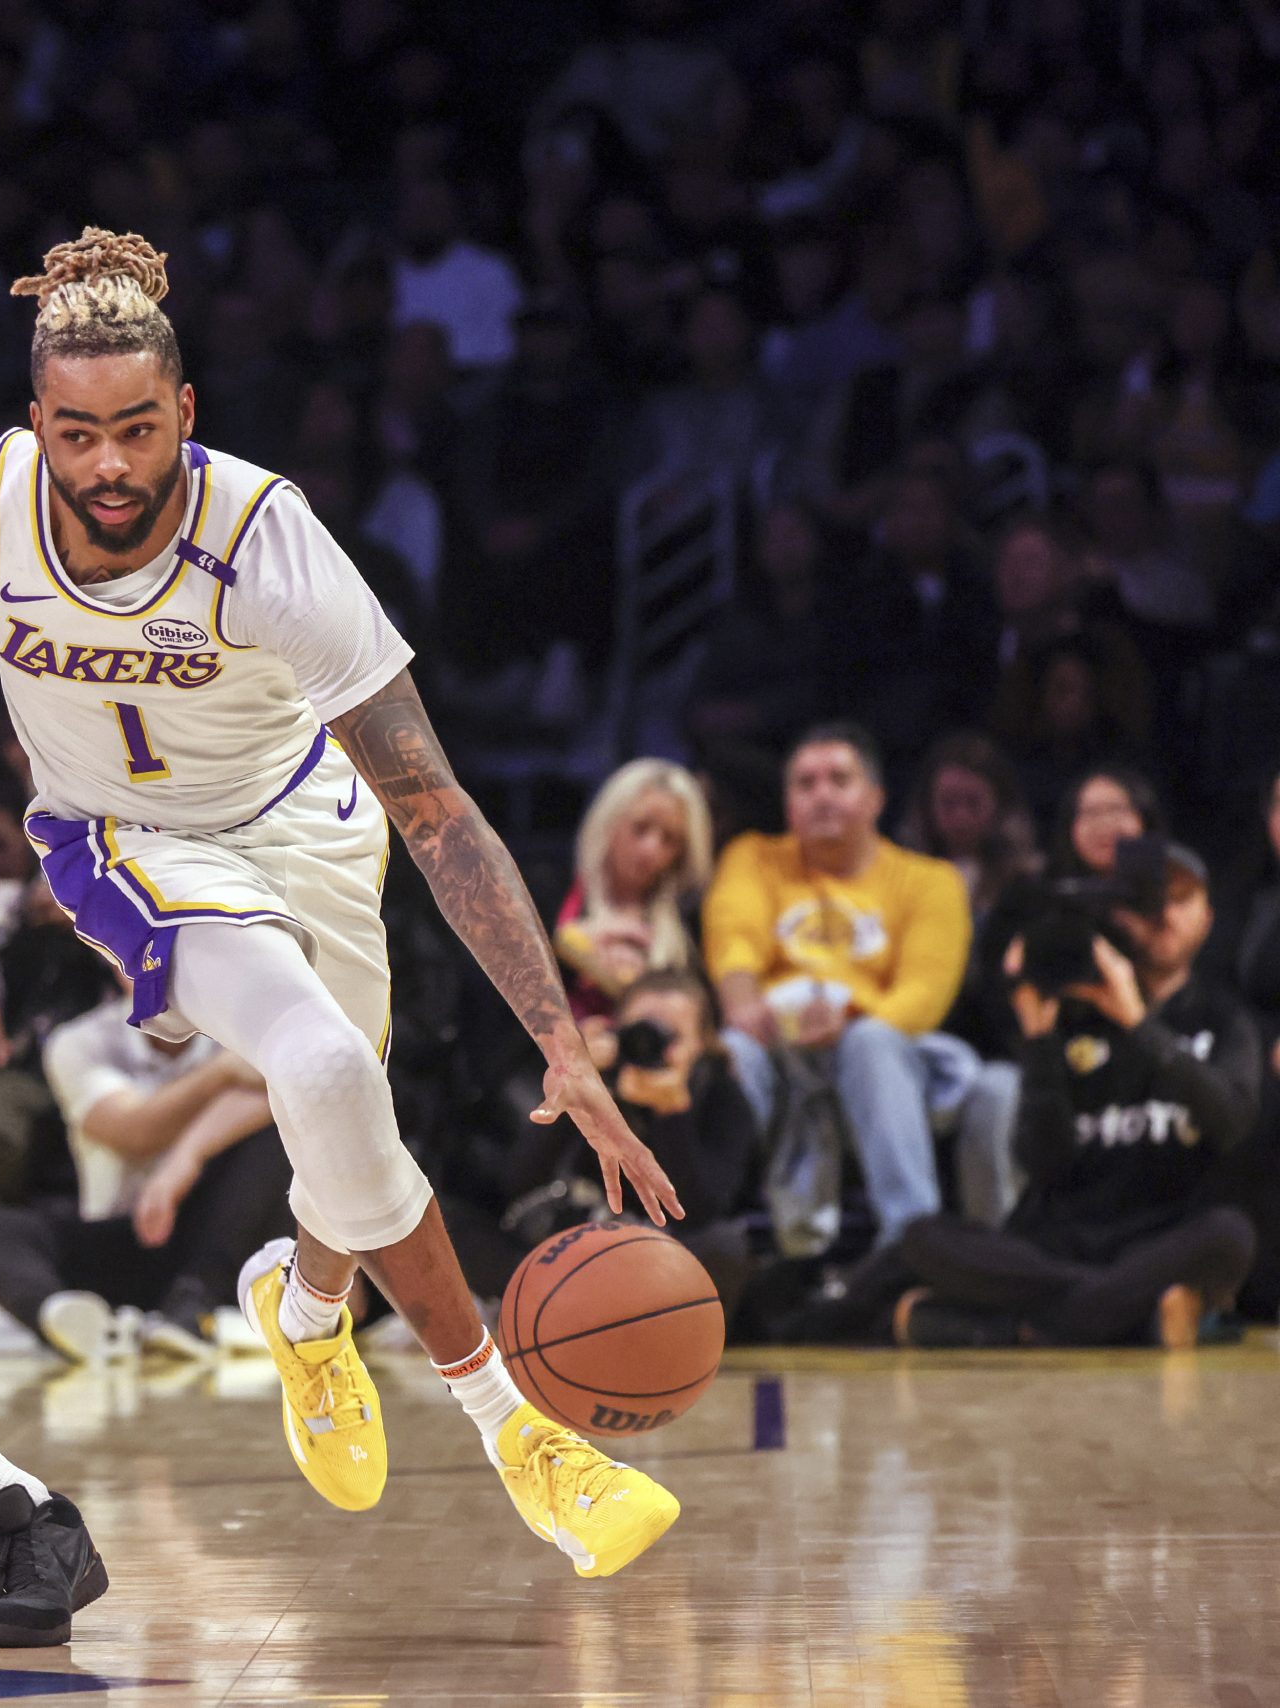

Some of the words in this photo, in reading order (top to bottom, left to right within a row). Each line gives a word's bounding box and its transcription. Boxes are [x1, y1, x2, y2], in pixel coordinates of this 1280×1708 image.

[198, 553, 217, 572] 44
[148, 625, 205, 643] bibigo
[101, 699, 173, 785] 1
